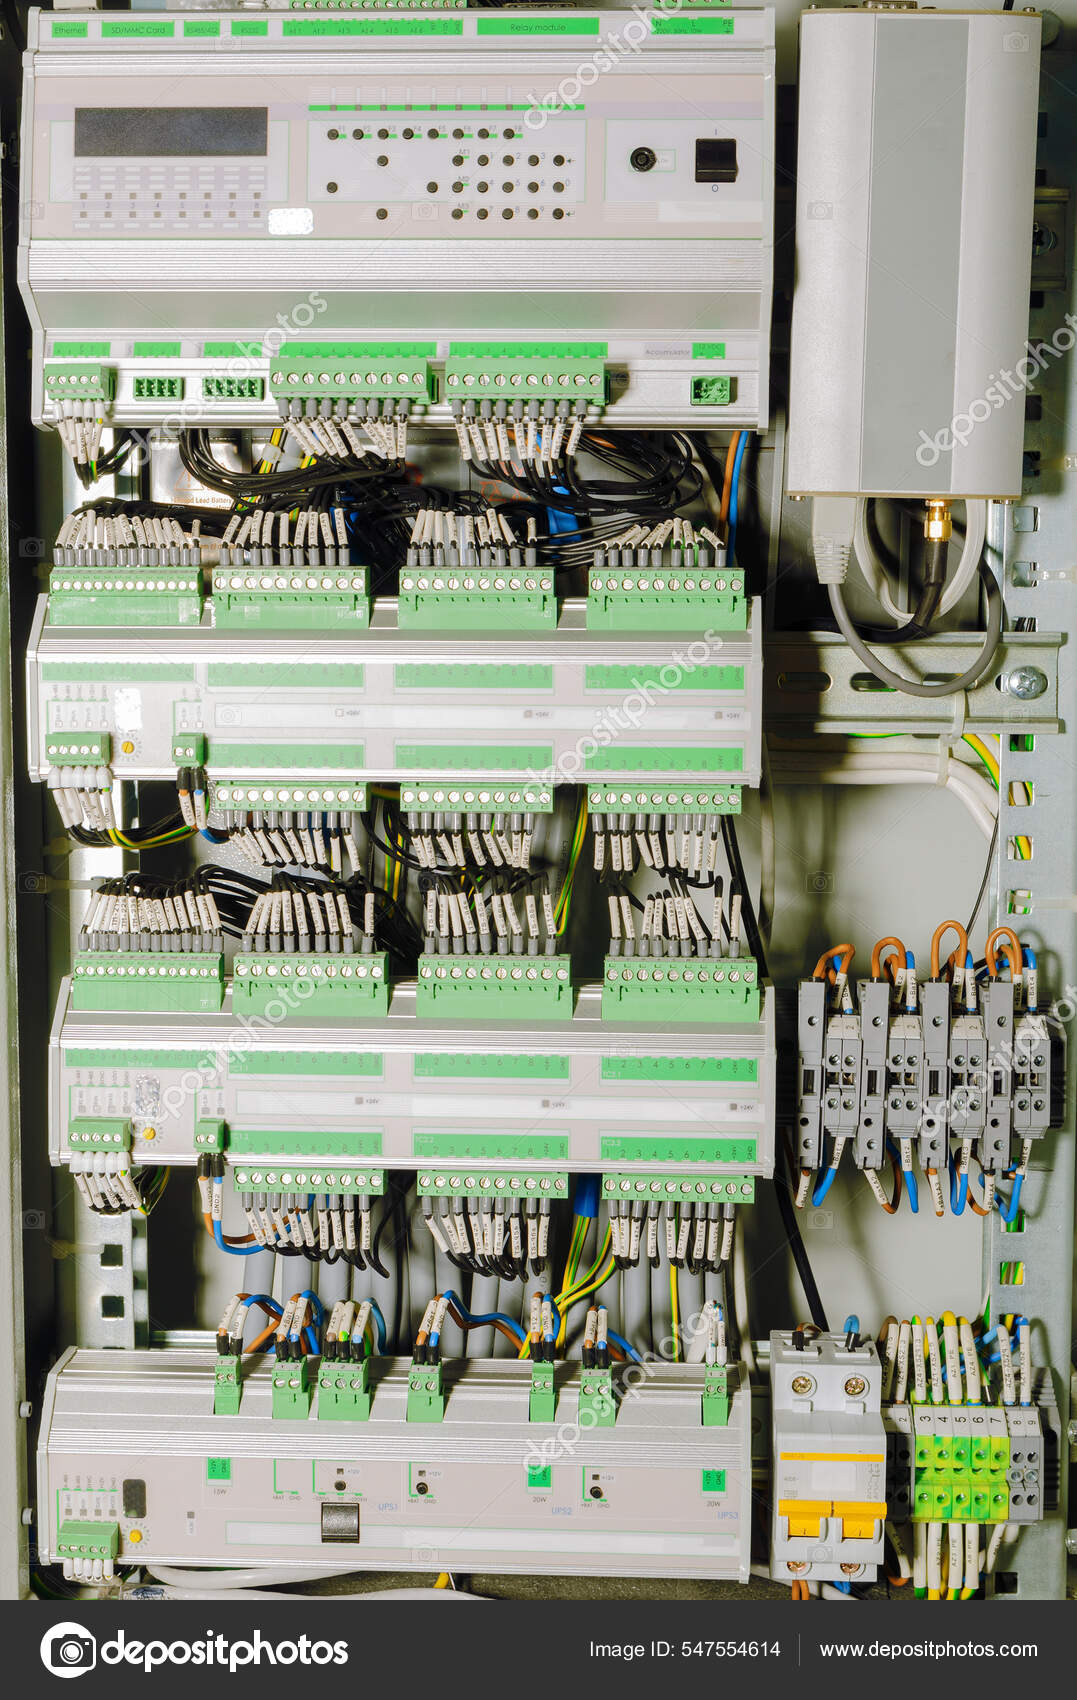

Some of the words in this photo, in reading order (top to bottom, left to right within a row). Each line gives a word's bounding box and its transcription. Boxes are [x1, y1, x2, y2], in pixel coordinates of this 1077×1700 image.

[54, 26, 86, 34] Ethernet
[146, 26, 166, 34] Card
[510, 23, 533, 32] Relay
[535, 23, 567, 31] module
[211, 497, 232, 505] Battery
[961, 1144, 969, 1168] -Bat3
[919, 1415, 932, 1424] 3
[954, 1416, 967, 1424] 5
[972, 1416, 984, 1424] 6
[378, 1503, 398, 1511] UPS1
[706, 1500, 721, 1508] 20W
[551, 1506, 572, 1516] UPS2
[717, 1511, 739, 1520] UPS3
